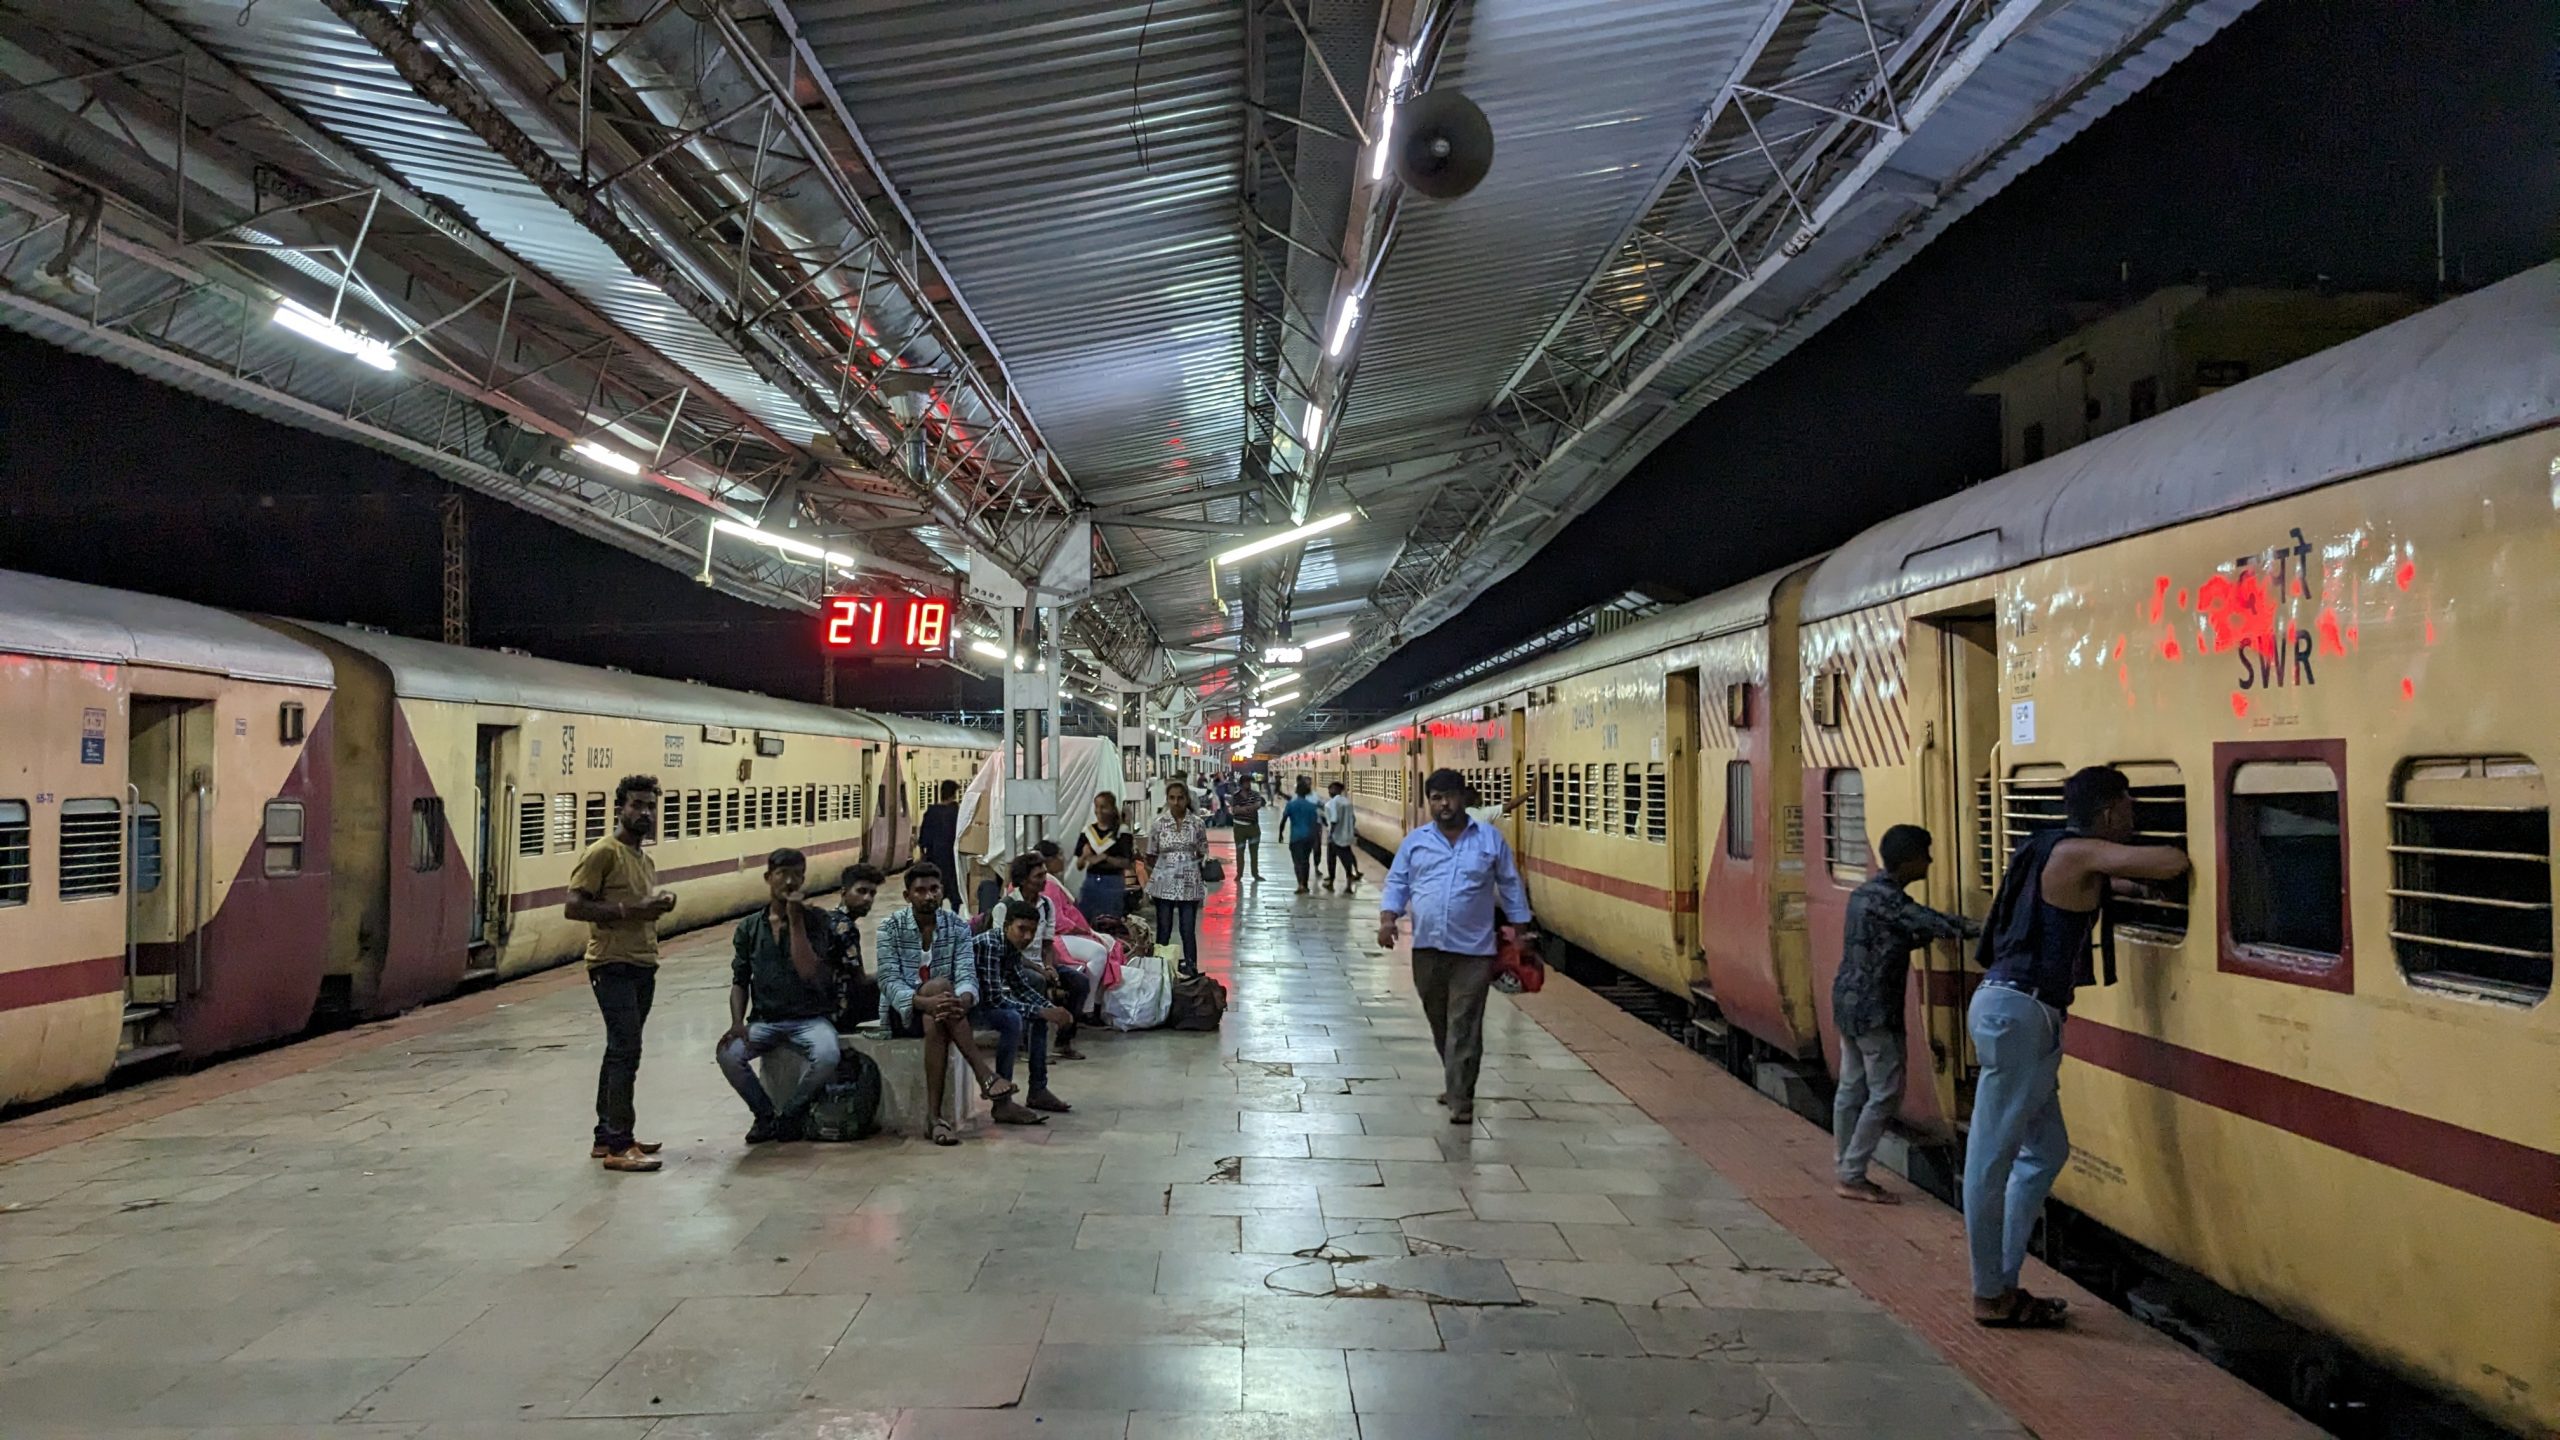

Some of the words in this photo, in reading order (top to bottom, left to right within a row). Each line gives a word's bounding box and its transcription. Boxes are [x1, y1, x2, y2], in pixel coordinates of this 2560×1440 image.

[2238, 628, 2315, 690] SWR
[562, 754, 573, 775] SE
[587, 747, 613, 768] 118251
[664, 753, 683, 768] SLEEPER
